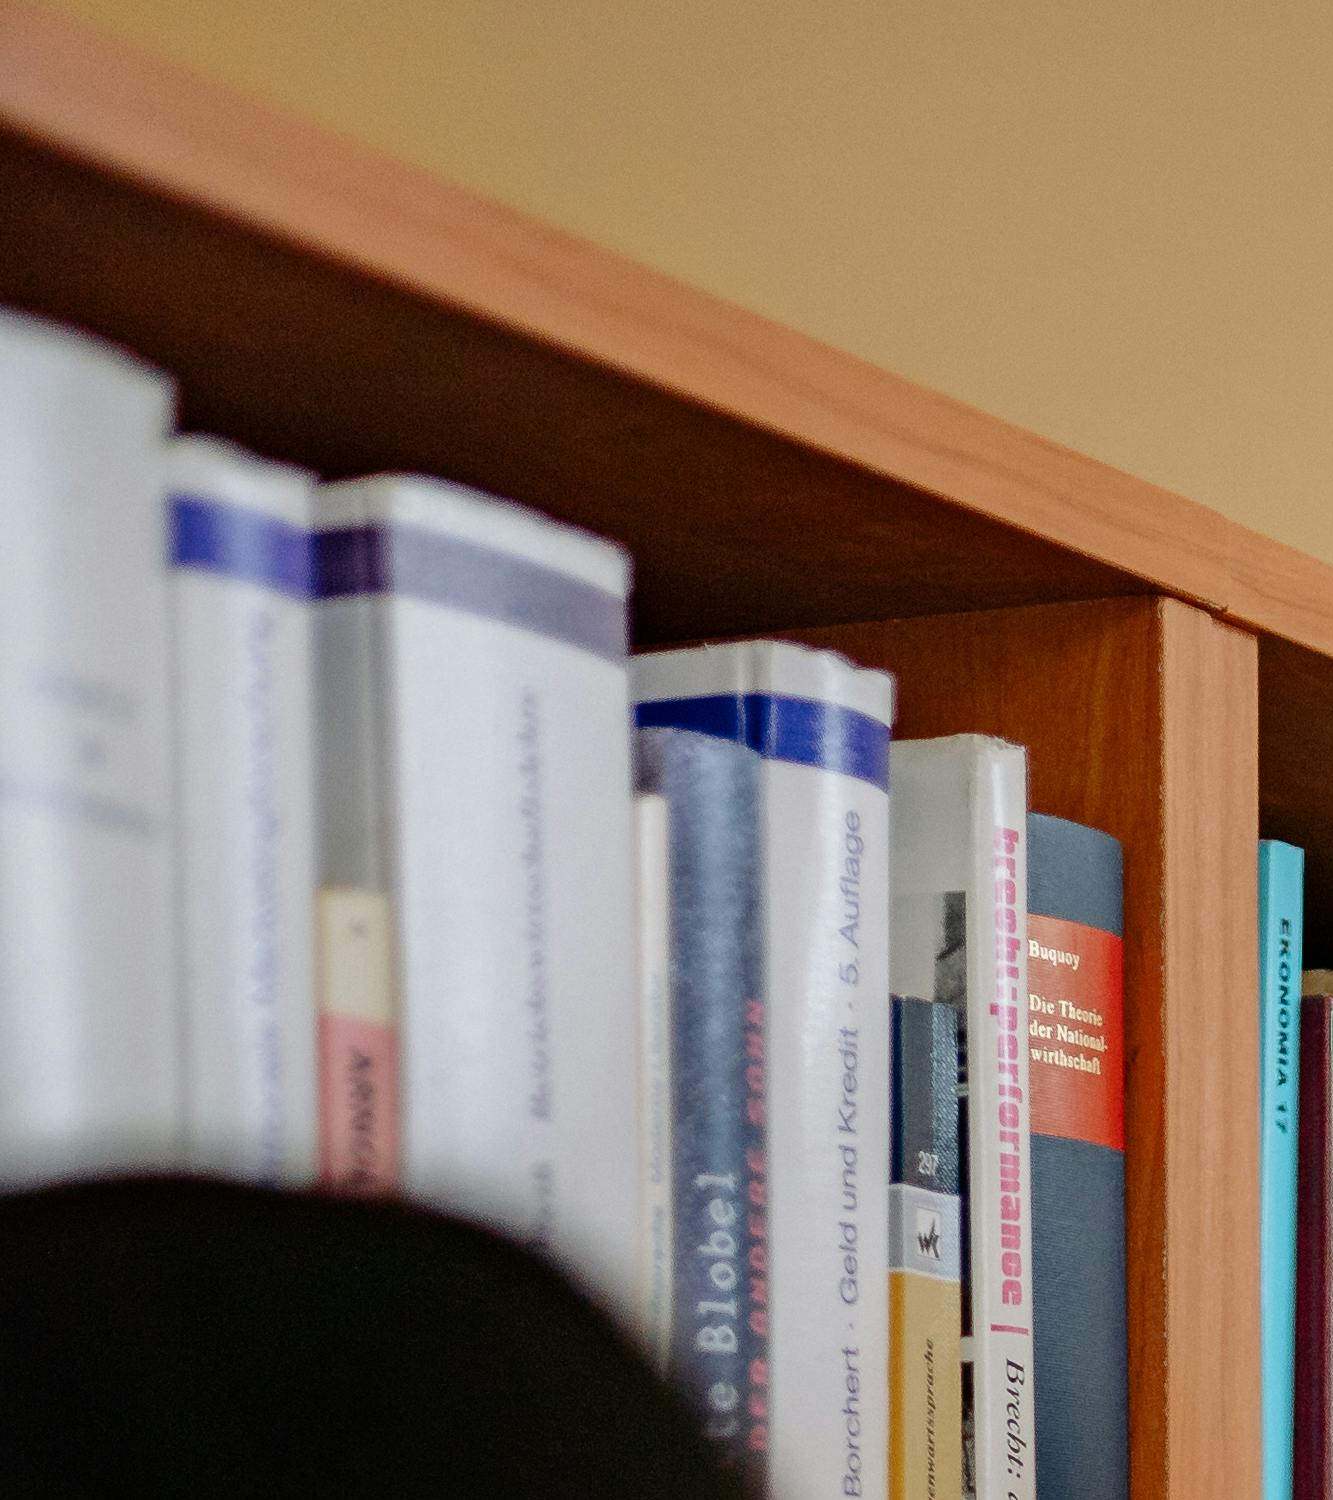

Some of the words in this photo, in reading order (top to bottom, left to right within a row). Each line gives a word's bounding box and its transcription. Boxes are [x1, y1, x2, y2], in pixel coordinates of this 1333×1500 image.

[838, 808, 864, 949] Auflage
[1028, 939, 1081, 971] Buquoy
[1029, 993, 1055, 1014] Die
[1058, 1000, 1103, 1027] Theorie
[1029, 1019, 1053, 1040] der
[1056, 1023, 1108, 1053] National-
[1277, 917, 1292, 1087] EKONOMIA
[838, 1025, 859, 1136] Kredit
[1031, 1046, 1102, 1075] wirthschaft
[839, 1144, 858, 1212] und
[918, 1150, 938, 1176] 297
[697, 1171, 739, 1353] Blobel
[839, 1220, 860, 1306] Geld
[841, 1346, 864, 1499] Borchert
[1006, 1358, 1029, 1477] Brecht:
